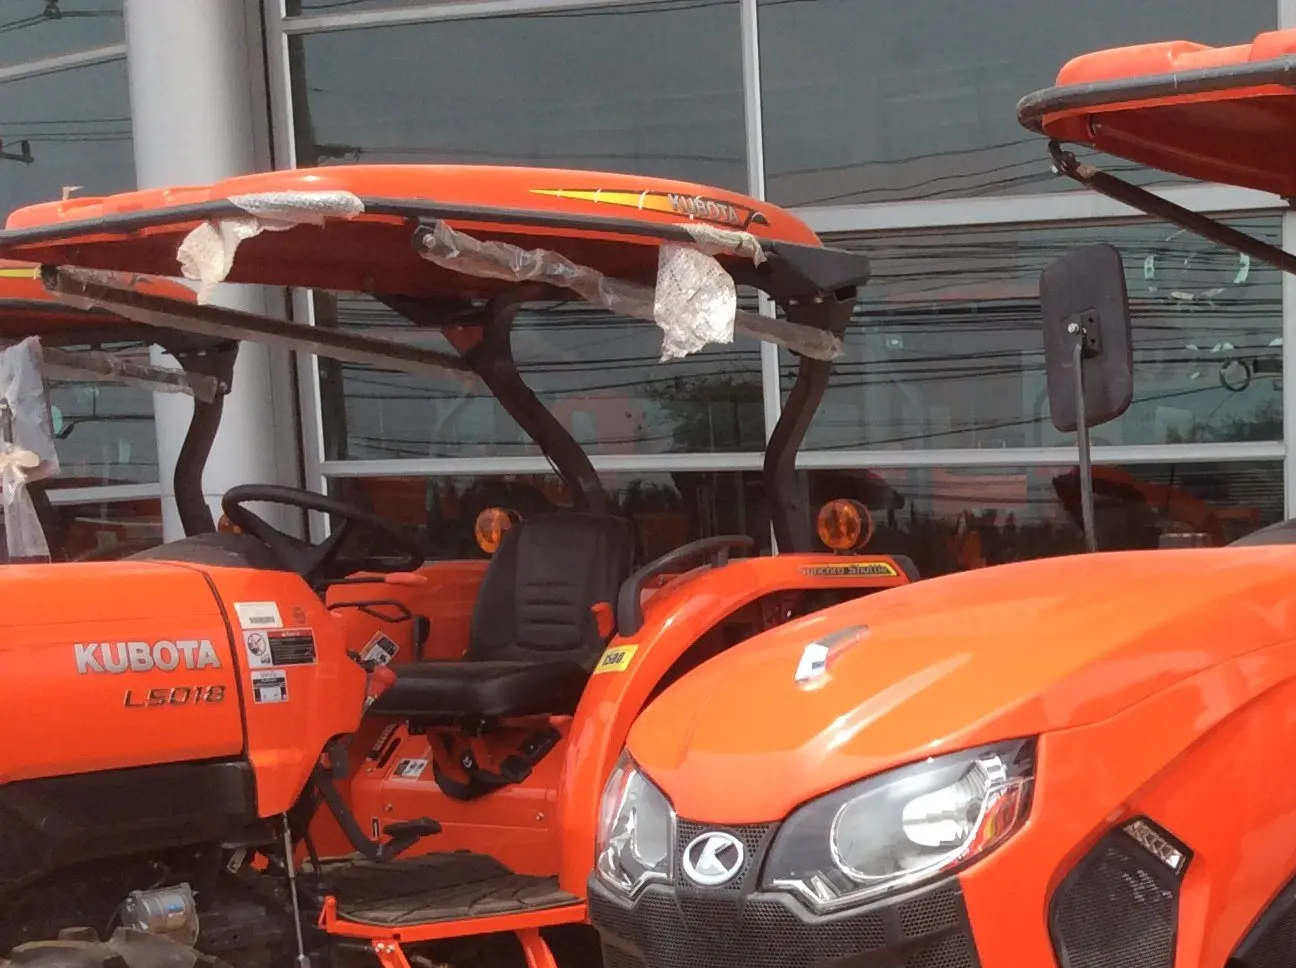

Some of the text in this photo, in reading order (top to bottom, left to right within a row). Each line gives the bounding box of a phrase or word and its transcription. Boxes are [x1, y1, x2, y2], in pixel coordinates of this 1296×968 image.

[667, 193, 740, 224] KUBOTA
[74, 639, 221, 675] KUBOTA
[123, 685, 226, 708] L5018
